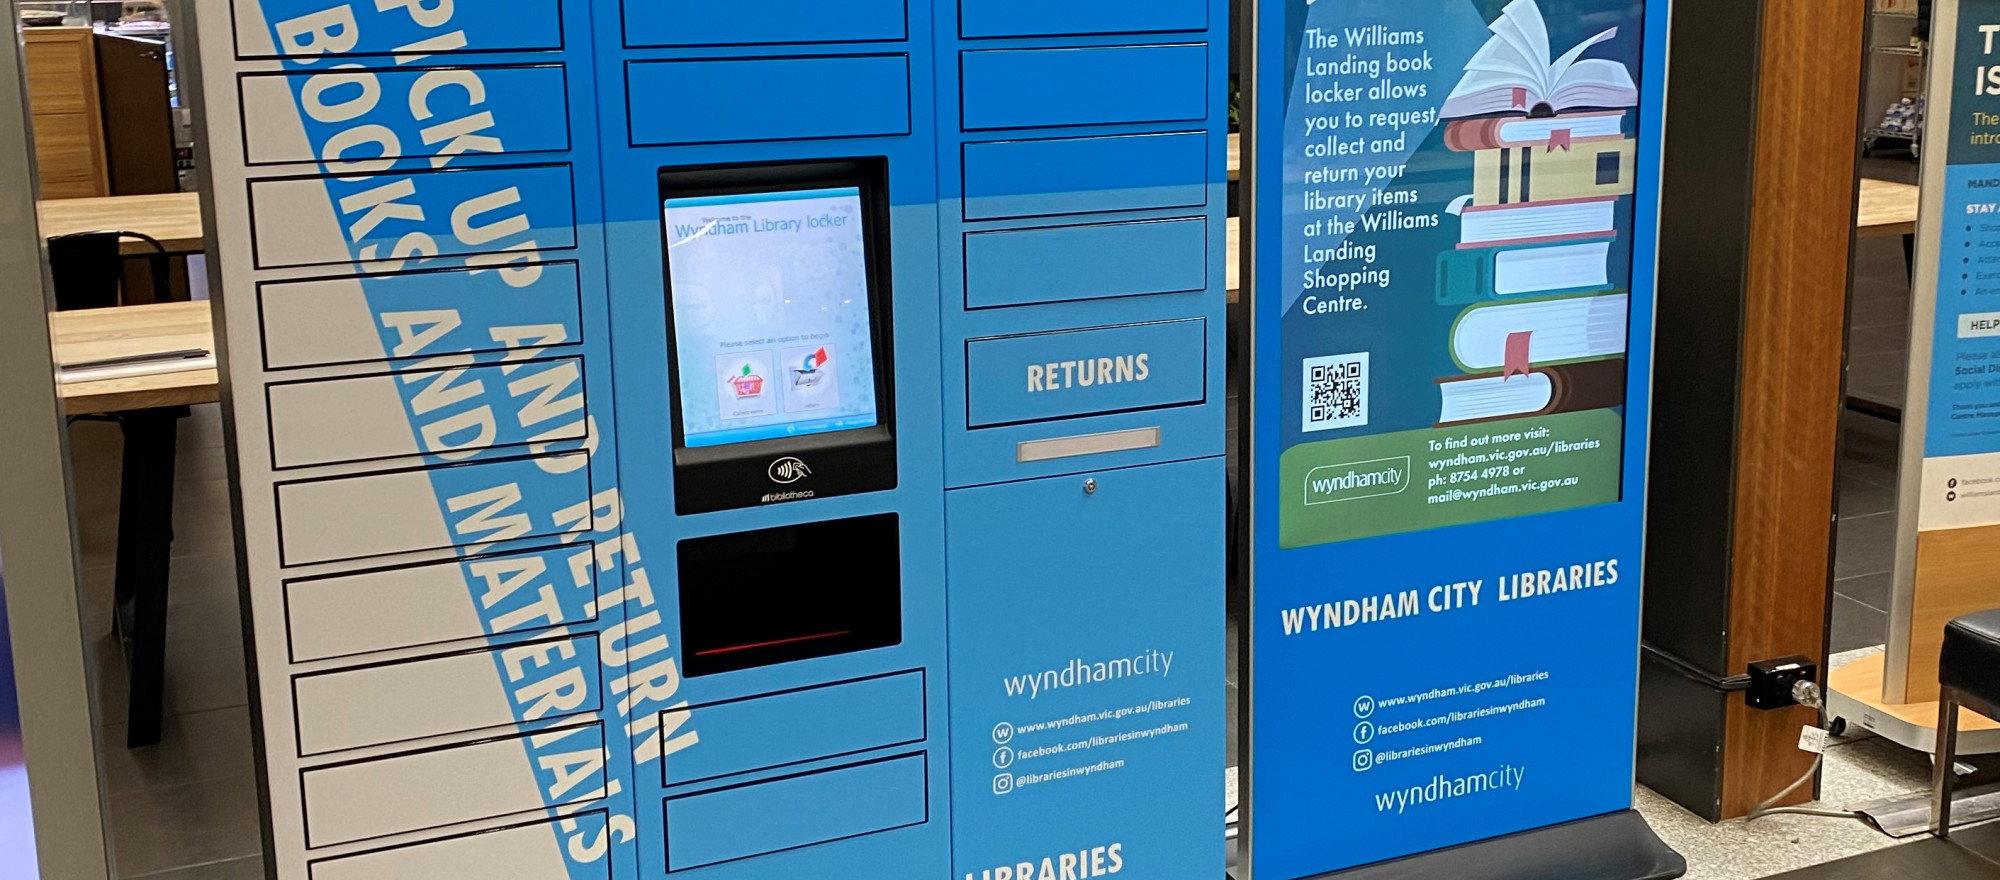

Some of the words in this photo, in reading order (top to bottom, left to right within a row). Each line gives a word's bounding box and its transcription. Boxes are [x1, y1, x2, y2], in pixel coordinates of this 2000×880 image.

[1306, 29, 1338, 49] The
[1344, 26, 1425, 48] Williams
[1306, 54, 1380, 79] Landing
[1386, 51, 1433, 72] book
[374, 0, 504, 168] PICK
[1305, 83, 1364, 104] locker
[1368, 80, 1428, 100] allows
[1304, 115, 1341, 136] you
[1345, 110, 1364, 127] to
[1368, 106, 1441, 133] request,
[1972, 112, 1999, 126] The
[1304, 137, 1369, 158] collect
[1372, 131, 1406, 152] and
[1304, 167, 1359, 185] return
[1364, 163, 1407, 187] your
[1304, 189, 1366, 213] library
[1371, 188, 1418, 206] items
[1966, 203, 1995, 214] STAY
[450, 186, 543, 289] UP
[753, 218, 801, 233] Library
[806, 214, 848, 229] locker
[1303, 220, 1323, 237] at
[1327, 215, 1356, 235] the
[1360, 211, 1439, 233] Williams
[1303, 242, 1377, 264] Landing
[1303, 265, 1391, 290] Shopping
[1302, 295, 1368, 316] Centre.
[1027, 353, 1149, 392] RETURNS
[1955, 364, 1986, 375] Social
[489, 323, 600, 475] AND
[275, 4, 440, 281] BOOKS
[379, 309, 498, 462] AND
[446, 483, 636, 865] MATERIALS
[1428, 440, 1442, 452] To
[1445, 436, 1469, 450] find
[1472, 434, 1491, 448] out
[1492, 432, 1522, 445] more
[1523, 427, 1551, 442] visit:
[1428, 438, 1601, 470] wyndham.vic.gov.au/libraries
[1312, 467, 1403, 495] wyndhamcity
[1427, 475, 1579, 504] mail@wyndham.vic.gov.au
[1428, 475, 1448, 490] ph:
[1449, 470, 1479, 484] 8754
[1480, 465, 1510, 480] 4978
[1512, 464, 1526, 476] or
[770, 489, 814, 501] bibliotheca
[1281, 590, 1420, 636] WYNDHAM
[1427, 580, 1483, 613] CITY
[1499, 558, 1620, 603] LIBRARIES
[552, 487, 699, 765] RETURN
[1003, 648, 1174, 700] wyndhamcity
[1377, 670, 1549, 709] www.wyndham.vic.gov.au/libraries
[1016, 696, 1191, 734] www.wyndham.vic.gov.au/libraries
[1377, 697, 1546, 736] facebook.com/librariesinwyndham
[1016, 721, 1189, 760] facebook.com/librariesinwyndham
[1375, 735, 1482, 765] @librariesinwyndham
[1015, 758, 1125, 788] @librariesinwyndham
[1375, 764, 1525, 815] wyndhamcity
[965, 842, 1123, 880] RARIES
